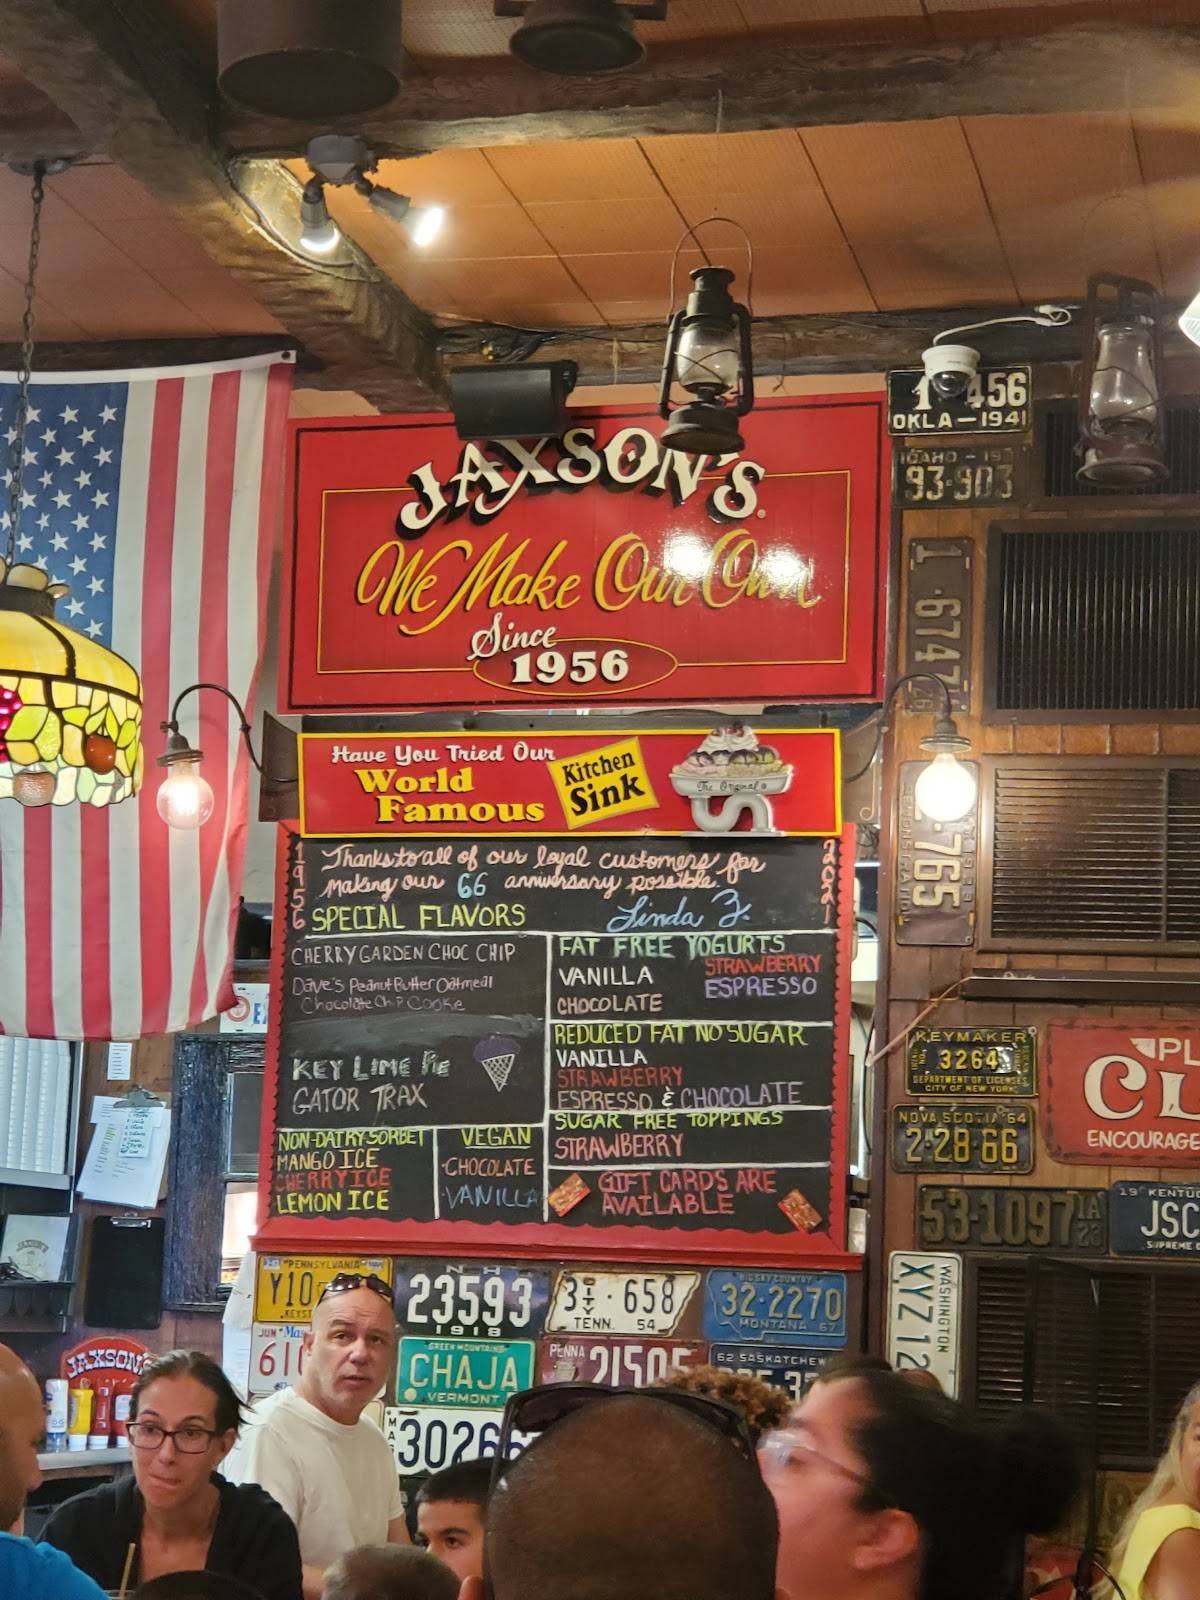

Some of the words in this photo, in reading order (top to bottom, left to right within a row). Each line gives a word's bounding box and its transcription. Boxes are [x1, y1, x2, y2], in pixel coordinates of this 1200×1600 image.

[356, 538, 437, 616] We
[399, 532, 581, 636] Make
[596, 532, 701, 612] Our
[467, 612, 557, 661] Since
[511, 648, 630, 684] 1956
[331, 745, 388, 765] Have
[394, 745, 440, 766] You
[446, 742, 505, 763] Tried
[513, 741, 557, 763] Our
[353, 766, 475, 794] World
[562, 751, 637, 787] Kitchen
[570, 772, 646, 818] Sink
[376, 795, 545, 824] Famous
[321, 843, 394, 872] Thanks
[421, 846, 453, 867] all
[457, 844, 478, 872] of
[486, 849, 529, 865] our
[532, 845, 591, 878] loyal
[599, 851, 720, 873] customers
[716, 851, 767, 885] for
[401, 874, 446, 891] our
[457, 872, 489, 899] 66
[312, 903, 406, 931] SPECIAL
[419, 902, 526, 930] FLAVORS
[606, 895, 704, 933] Linda
[291, 946, 357, 967] CHERRY
[359, 945, 426, 964] GARDEN
[427, 942, 471, 962] CHOC
[475, 943, 516, 962] CHIP
[559, 935, 600, 957] FAT
[613, 936, 677, 959] FREE
[686, 933, 786, 960] YOGURTS
[558, 966, 654, 987] VANILLA
[704, 953, 823, 977] STRAWBERRY
[291, 976, 345, 996] Dave's
[349, 977, 395, 995] Peanut
[704, 976, 818, 999] ESPRESSO
[557, 993, 663, 1015] CHOCOLATE
[554, 1023, 642, 1045] REDUCED
[650, 1023, 688, 1044] FAT
[695, 1023, 723, 1043] NO
[726, 1023, 808, 1046] SUGAR
[915, 1031, 1027, 1042] KEYMAKER
[292, 1057, 345, 1082] KEY
[352, 1054, 412, 1082] LIME
[555, 1048, 648, 1068] VANILLA
[940, 1048, 999, 1070] 3264
[556, 1066, 683, 1088] STRAWBERRY
[913, 1076, 967, 1084] DEPARTMENT
[971, 1076, 982, 1084] OF
[925, 1084, 946, 1092] CITY
[950, 1084, 962, 1092] OF
[965, 1085, 986, 1093] NEW
[991, 1085, 1014, 1093] YORK
[292, 1086, 360, 1115] GATOR
[369, 1082, 429, 1112] TRAX
[557, 1090, 653, 1111] ESPRESSO
[680, 1081, 804, 1110] CHOCOLATE
[554, 1111, 622, 1130] SUGAR
[633, 1112, 678, 1129] FREE
[686, 1110, 784, 1128] TOPPINGS
[900, 1112, 937, 1123] NOVA
[942, 1112, 998, 1123] SCOTIA
[366, 1127, 426, 1147] SORBET
[461, 1126, 532, 1147] VEGAN
[554, 1132, 684, 1162] STRAWBERRY
[277, 1150, 337, 1172] MANGO
[338, 1148, 382, 1169] ICE
[444, 1157, 537, 1178] CHOCOLATE
[350, 1168, 394, 1188] ICE
[597, 1170, 652, 1193] GIFT
[659, 1169, 730, 1193] CARDS
[735, 1169, 778, 1194] ARE
[277, 1192, 342, 1214] LEMON
[347, 1190, 391, 1212] ICE
[446, 1184, 540, 1209] VANILLA
[601, 1193, 735, 1216] AVAILABLE
[288, 1259, 361, 1270] PENNSYLVANIA
[407, 1273, 533, 1328] 23593
[936, 1264, 952, 1354] WASHINGTON
[285, 1309, 312, 1319] KEYST
[637, 1319, 656, 1331] 54
[740, 1319, 808, 1331] MONTANA
[820, 1322, 839, 1332] 67
[258, 1329, 278, 1338] JUN
[435, 1325, 501, 1337] 1918
[428, 1342, 455, 1350] GREEN
[549, 1343, 586, 1359] PENNA
[717, 1352, 735, 1362] 62
[740, 1353, 828, 1367] SASKATCHEW
[409, 1353, 519, 1393] CHAJA
[427, 1392, 500, 1404] VERMONT
